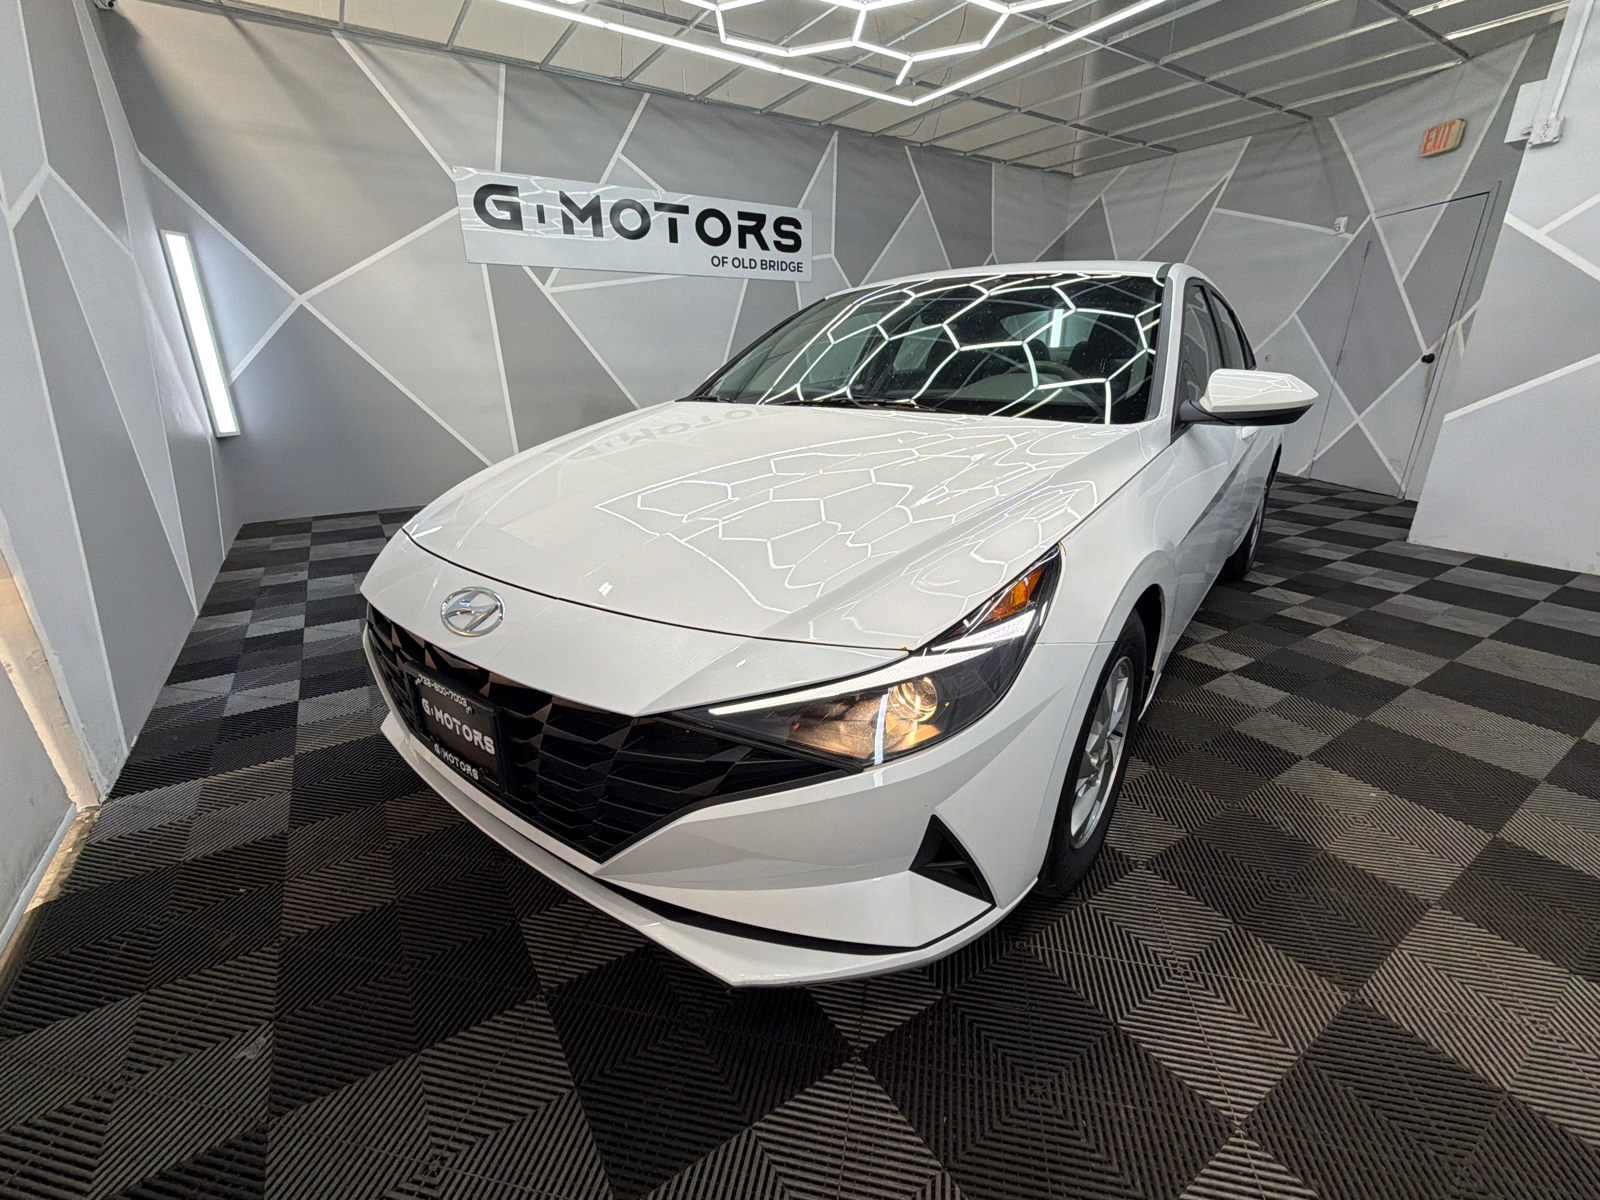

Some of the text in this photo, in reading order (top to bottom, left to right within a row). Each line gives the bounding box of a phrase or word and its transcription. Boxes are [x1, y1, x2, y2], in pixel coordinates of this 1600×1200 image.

[1422, 121, 1456, 154] EXIT
[711, 255, 804, 273] OF OLD BRIDGE
